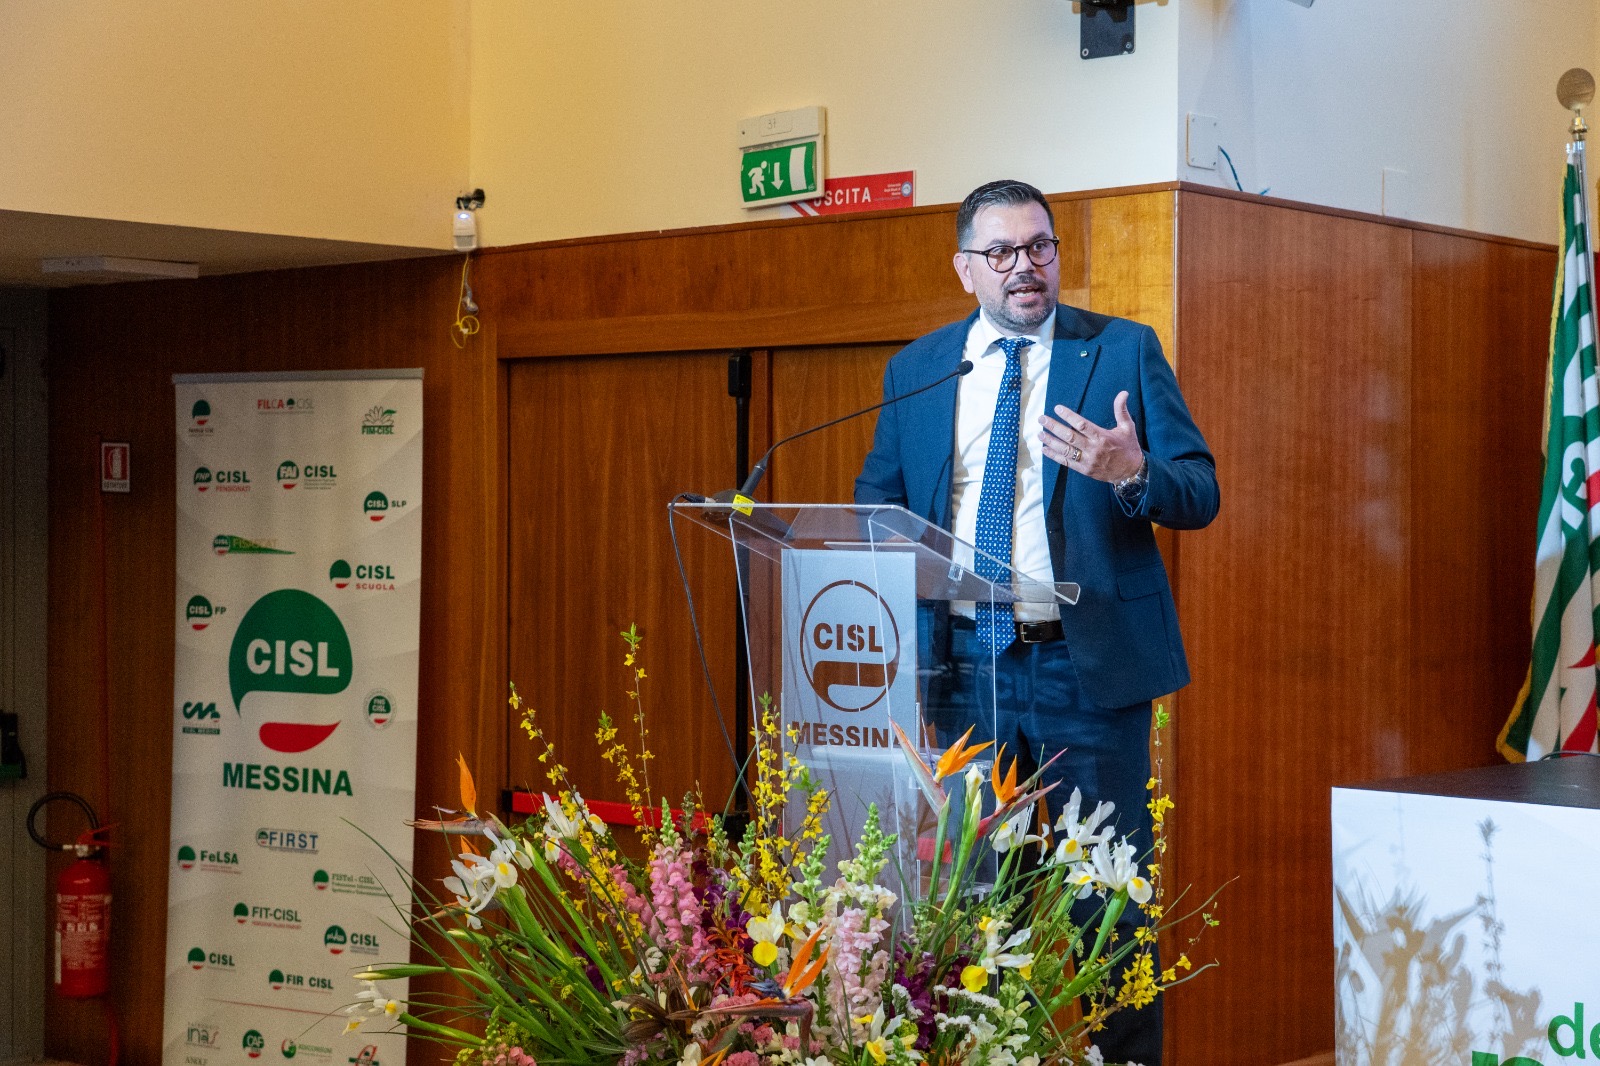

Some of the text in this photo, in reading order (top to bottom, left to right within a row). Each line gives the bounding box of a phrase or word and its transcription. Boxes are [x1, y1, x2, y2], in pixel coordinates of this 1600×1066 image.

[216, 471, 250, 483] CISL
[304, 465, 337, 478] CISL
[366, 500, 407, 508] CISL SLP
[356, 564, 395, 580] CISL
[356, 583, 395, 591] SCUOLA
[189, 605, 227, 615] CISL FP
[813, 622, 884, 653] CISL
[246, 638, 340, 677] CISL
[223, 762, 353, 797] MESSINA
[269, 831, 319, 849] FIRST
[200, 850, 239, 865] FeLSA
[252, 906, 301, 923] FIT-CISL
[350, 933, 380, 948] CISL
[209, 952, 236, 967] CISL
[286, 974, 304, 986] FIR
[309, 977, 334, 990] CISL
[1547, 1001, 1600, 1060] d
